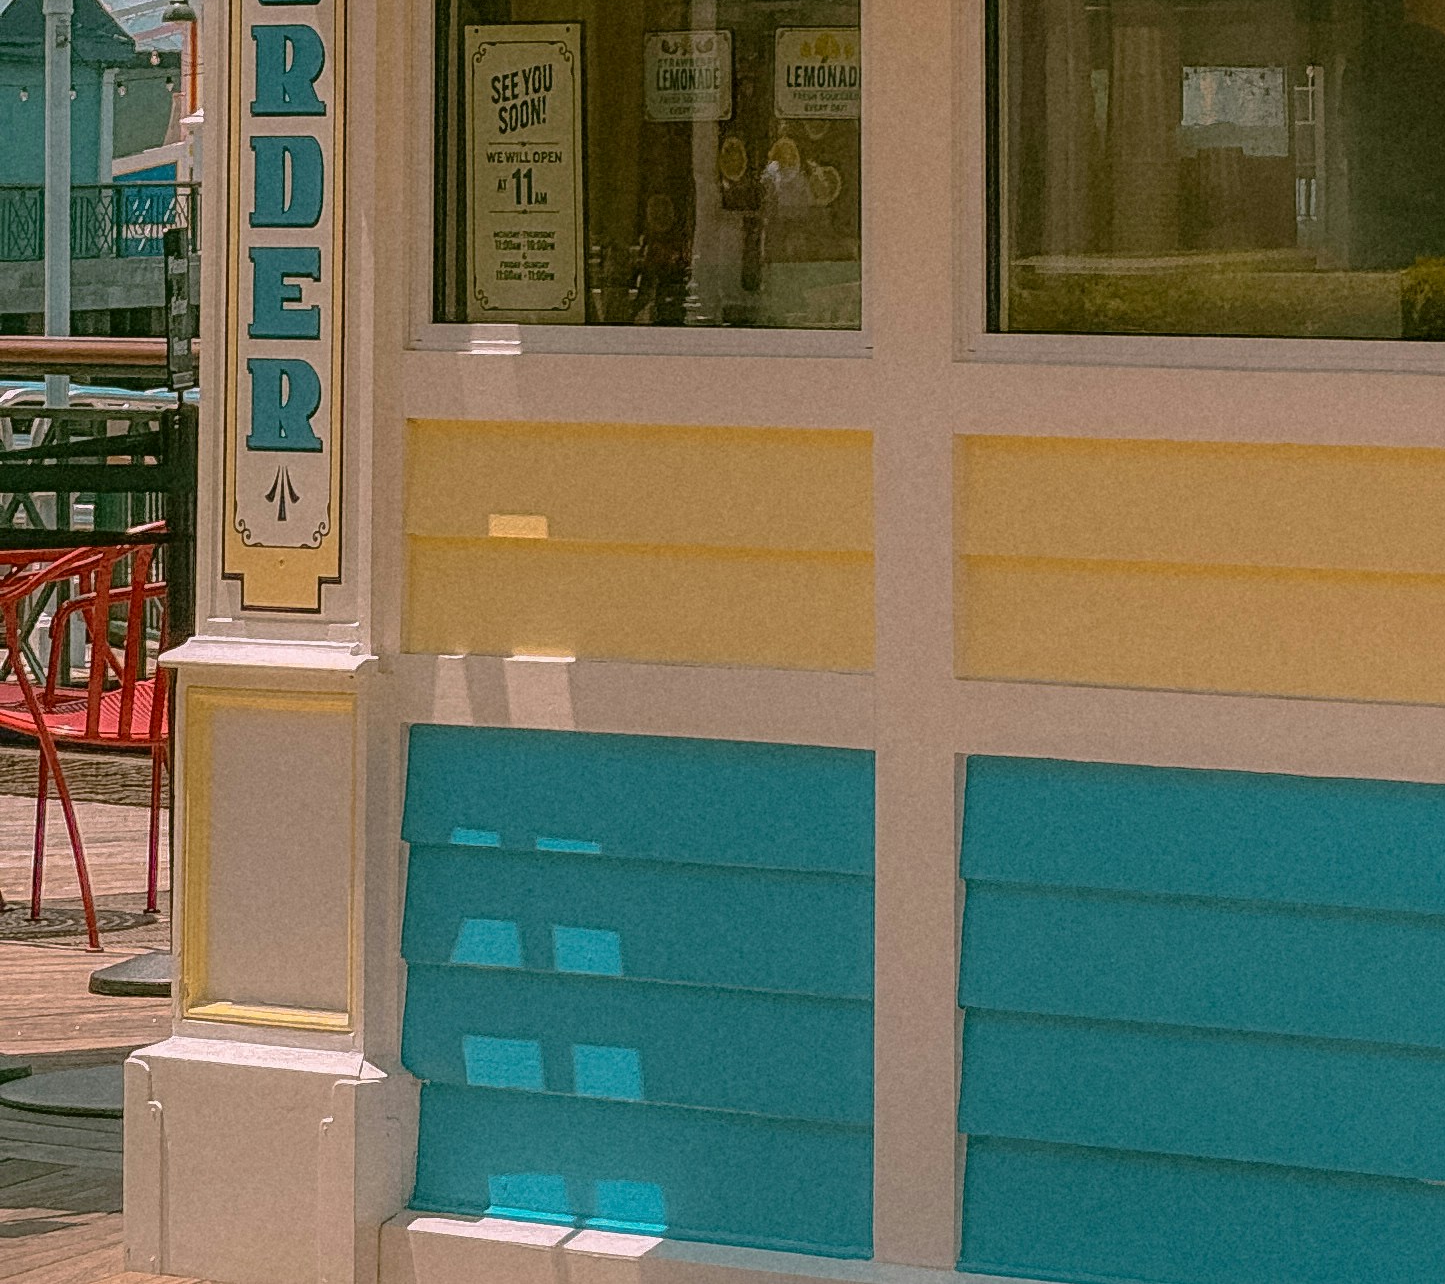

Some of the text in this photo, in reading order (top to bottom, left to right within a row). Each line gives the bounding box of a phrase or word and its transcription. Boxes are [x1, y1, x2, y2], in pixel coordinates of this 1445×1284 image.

[658, 57, 719, 68] STRAWB
[491, 64, 552, 104] SEE YOU
[657, 68, 720, 90] LEMONADE
[787, 64, 861, 87] LEMONAD
[499, 95, 546, 134] SOON!
[486, 151, 562, 163] WE WILL OPEN
[497, 179, 507, 191] AT
